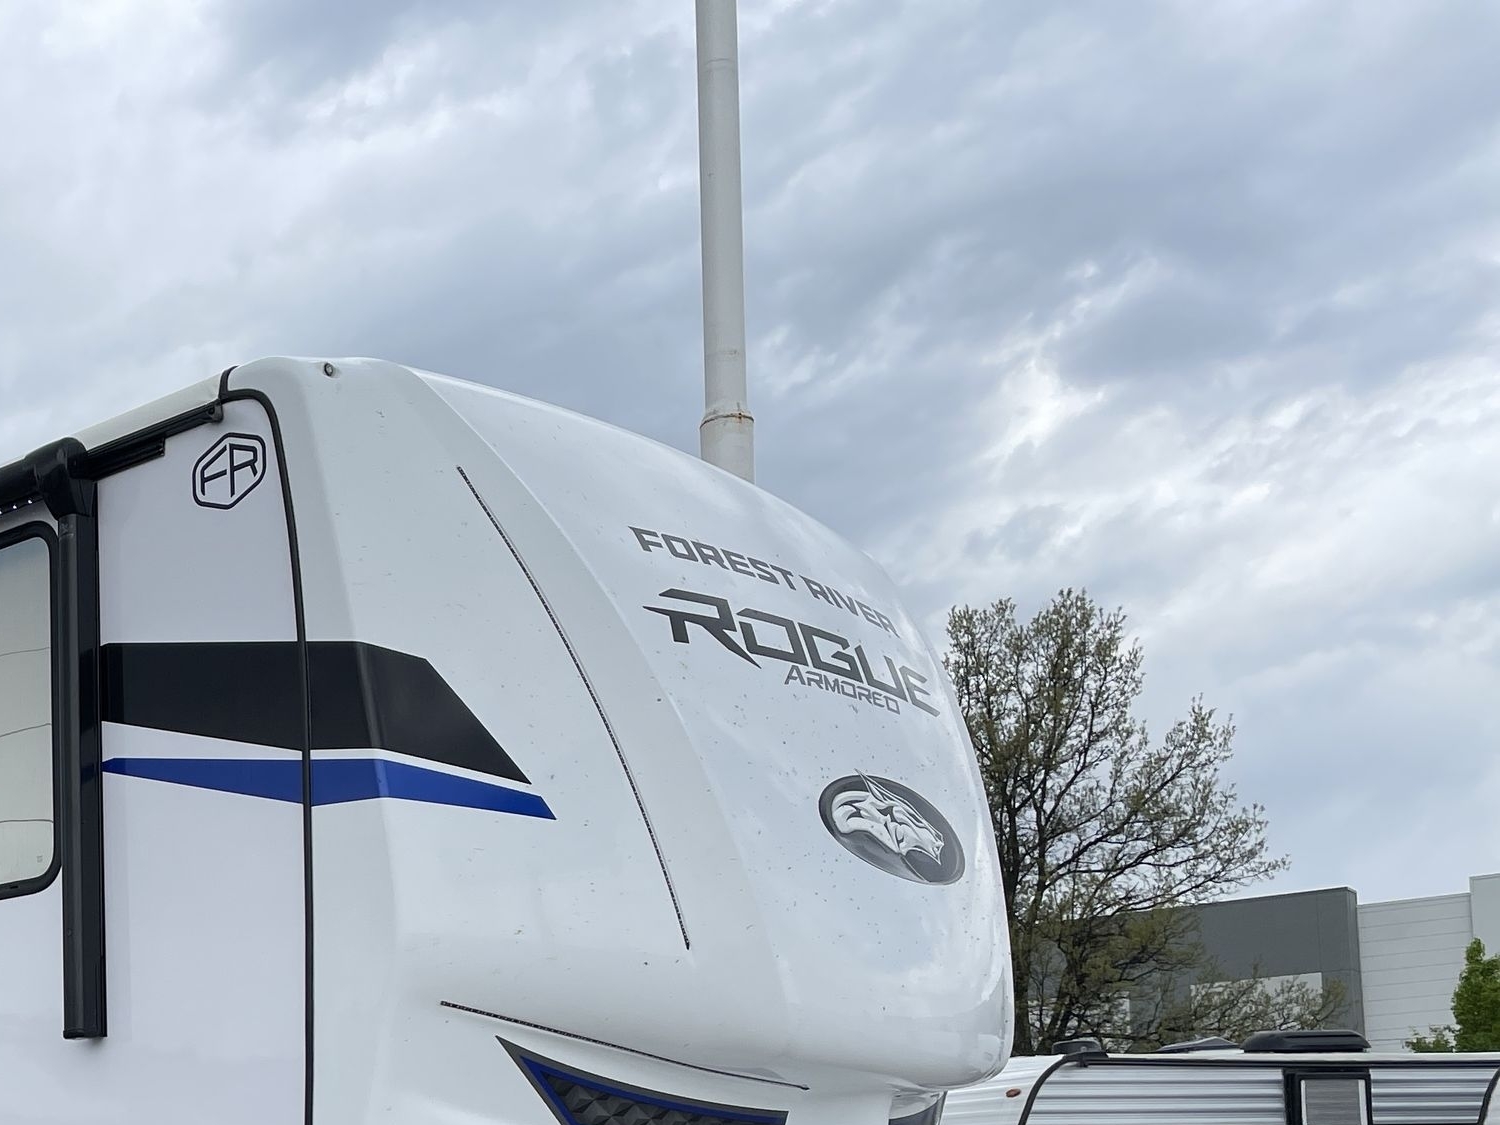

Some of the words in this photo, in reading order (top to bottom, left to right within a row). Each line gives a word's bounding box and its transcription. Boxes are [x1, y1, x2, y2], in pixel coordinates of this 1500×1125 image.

[628, 525, 797, 591] FOREST
[799, 574, 901, 639] RIVER
[642, 588, 940, 718] ROGUE
[784, 664, 901, 715] ARMORED
